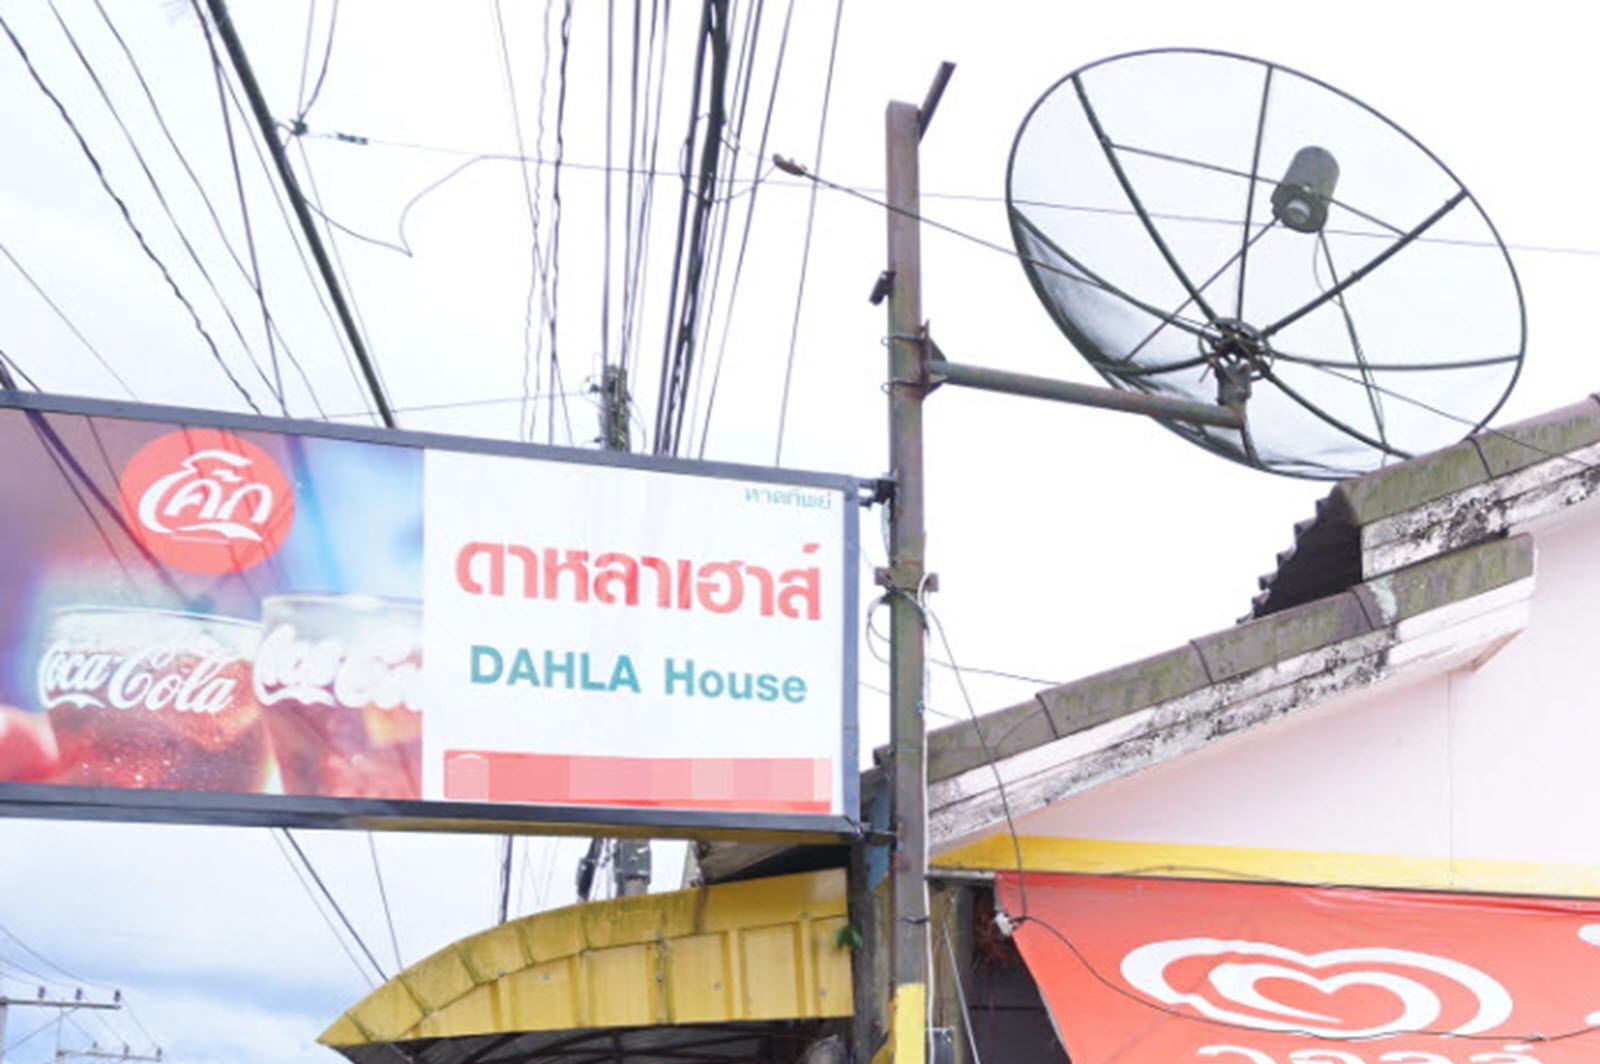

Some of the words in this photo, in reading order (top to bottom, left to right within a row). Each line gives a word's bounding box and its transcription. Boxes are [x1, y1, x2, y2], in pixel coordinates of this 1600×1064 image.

[454, 541, 822, 621] ดาหลาเฮาส์
[469, 644, 641, 694] DAHLA
[664, 657, 808, 704] House
